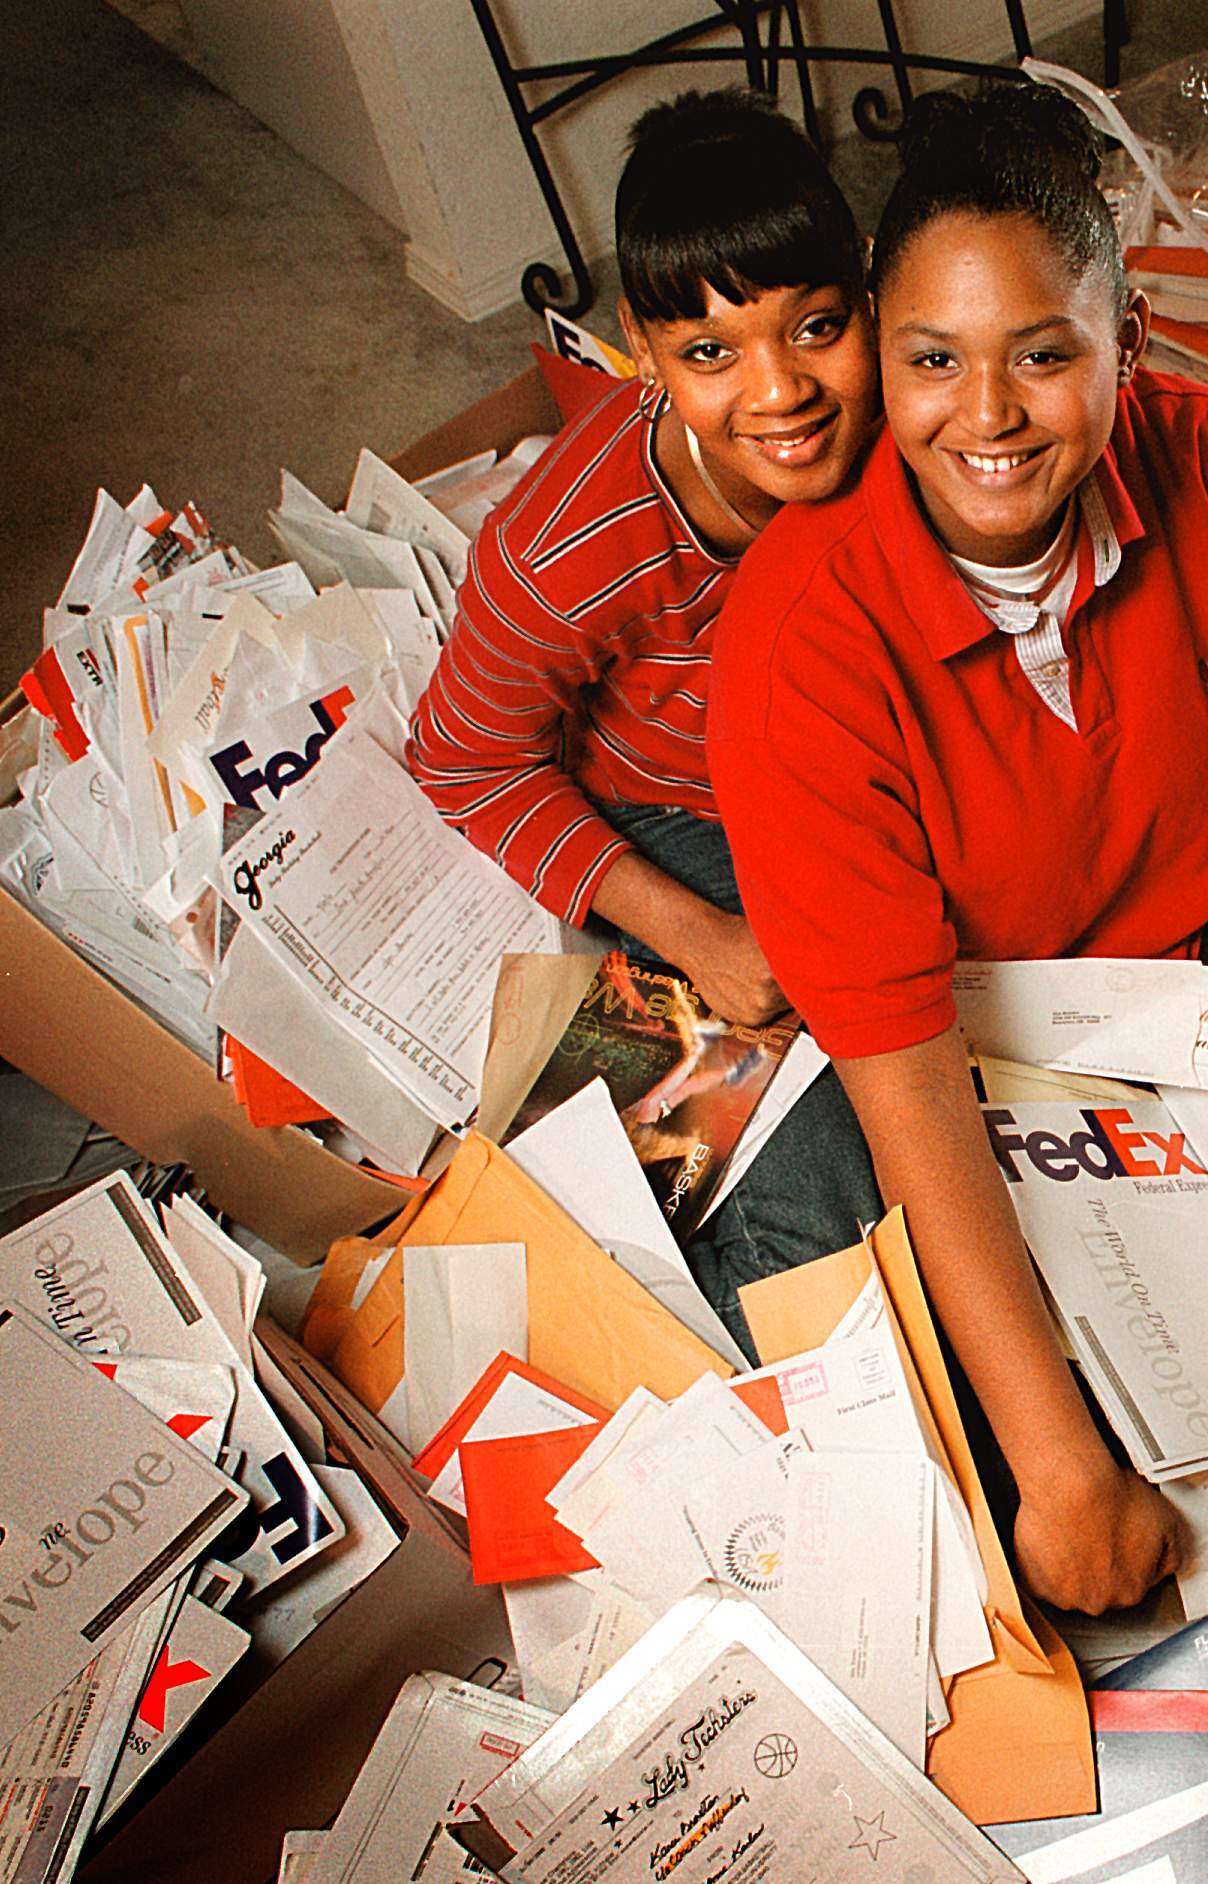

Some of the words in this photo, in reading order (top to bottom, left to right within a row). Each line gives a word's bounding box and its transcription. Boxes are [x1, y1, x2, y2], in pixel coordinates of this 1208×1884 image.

[234, 829, 294, 910] Georgia
[983, 1108, 1208, 1182] FedEx
[1133, 1181, 1173, 1196] Federal
[35, 1262, 72, 1326] Time
[1087, 1198, 1108, 1224] The
[1104, 1227, 1139, 1278] World
[1130, 1281, 1151, 1306] On
[1145, 1309, 1179, 1355] Time
[837, 1403, 858, 1417] First
[858, 1397, 877, 1411] Class
[877, 1389, 897, 1404] Mail
[642, 1754, 688, 1809] Lady
[682, 1692, 757, 1762] Techsters
